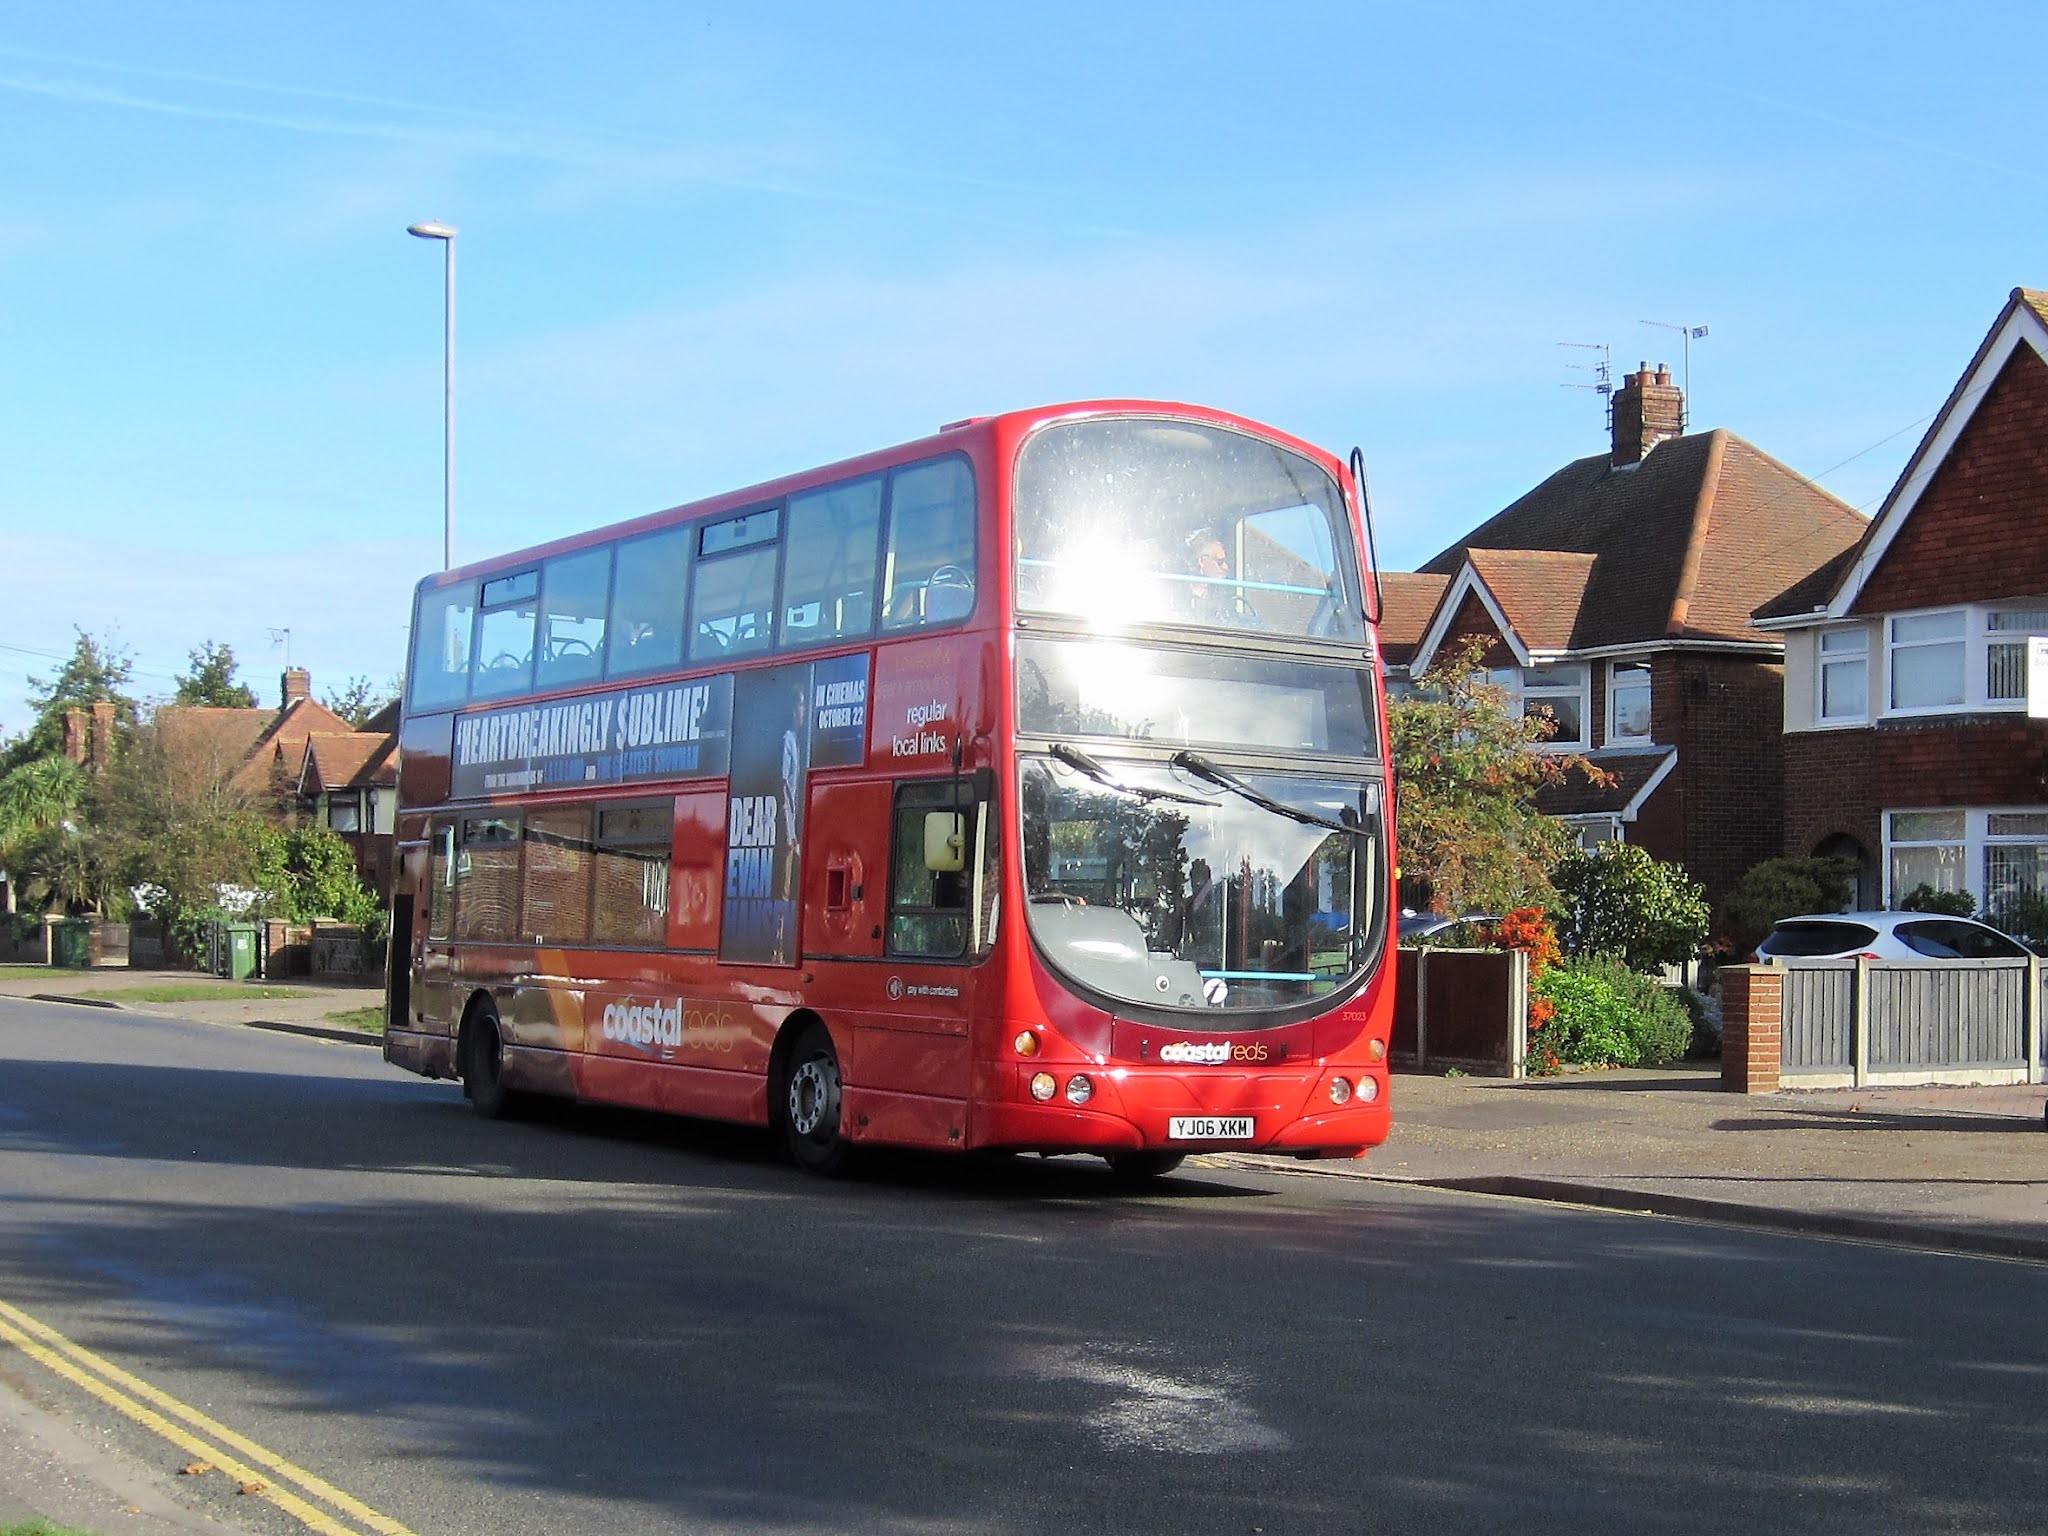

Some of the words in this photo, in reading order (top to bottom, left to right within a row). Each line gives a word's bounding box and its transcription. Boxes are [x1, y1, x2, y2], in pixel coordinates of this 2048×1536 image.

[816, 684, 826, 707] IN
[826, 680, 865, 706] CINEMAS
[819, 708, 851, 729] OCTOBER
[852, 706, 863, 726] 22
[906, 699, 948, 727] regular
[892, 732, 919, 757] local
[920, 731, 946, 754] links
[729, 795, 778, 847] DEAR
[727, 847, 774, 898] EVAN
[1342, 1011, 1367, 1022] 37023
[1177, 1120, 1215, 1136] YJ06
[1219, 1120, 1247, 1136] XKM
